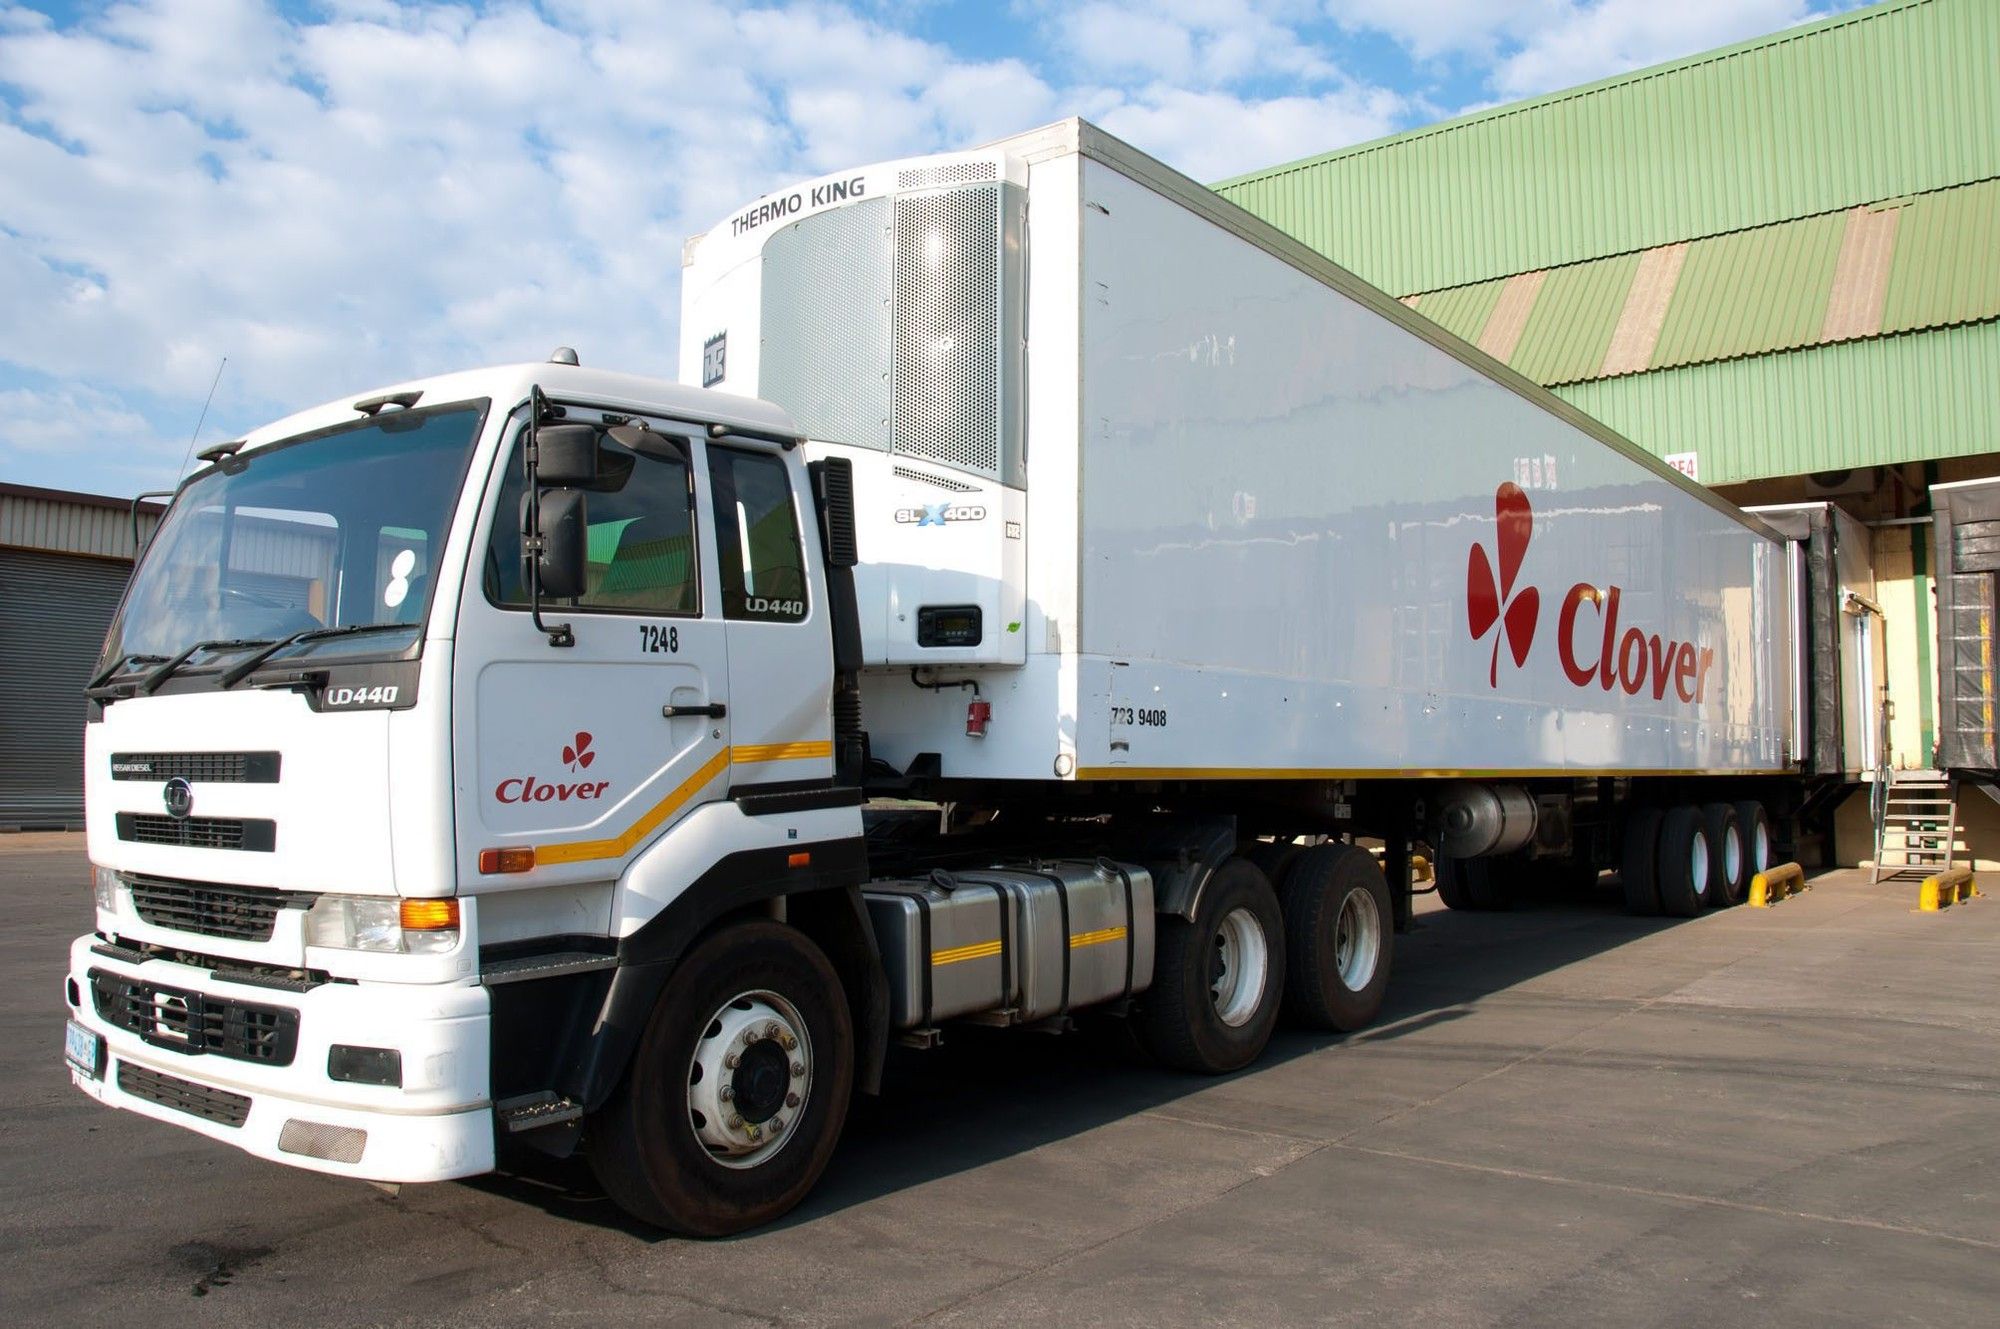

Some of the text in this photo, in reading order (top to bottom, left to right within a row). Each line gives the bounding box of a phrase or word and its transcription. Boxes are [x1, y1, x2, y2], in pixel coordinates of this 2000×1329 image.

[731, 176, 865, 238] THERMO KING
[639, 624, 679, 654] 7248
[1557, 581, 1714, 705] Clover
[1138, 709, 1167, 727] 9408
[495, 776, 610, 804] Clover
